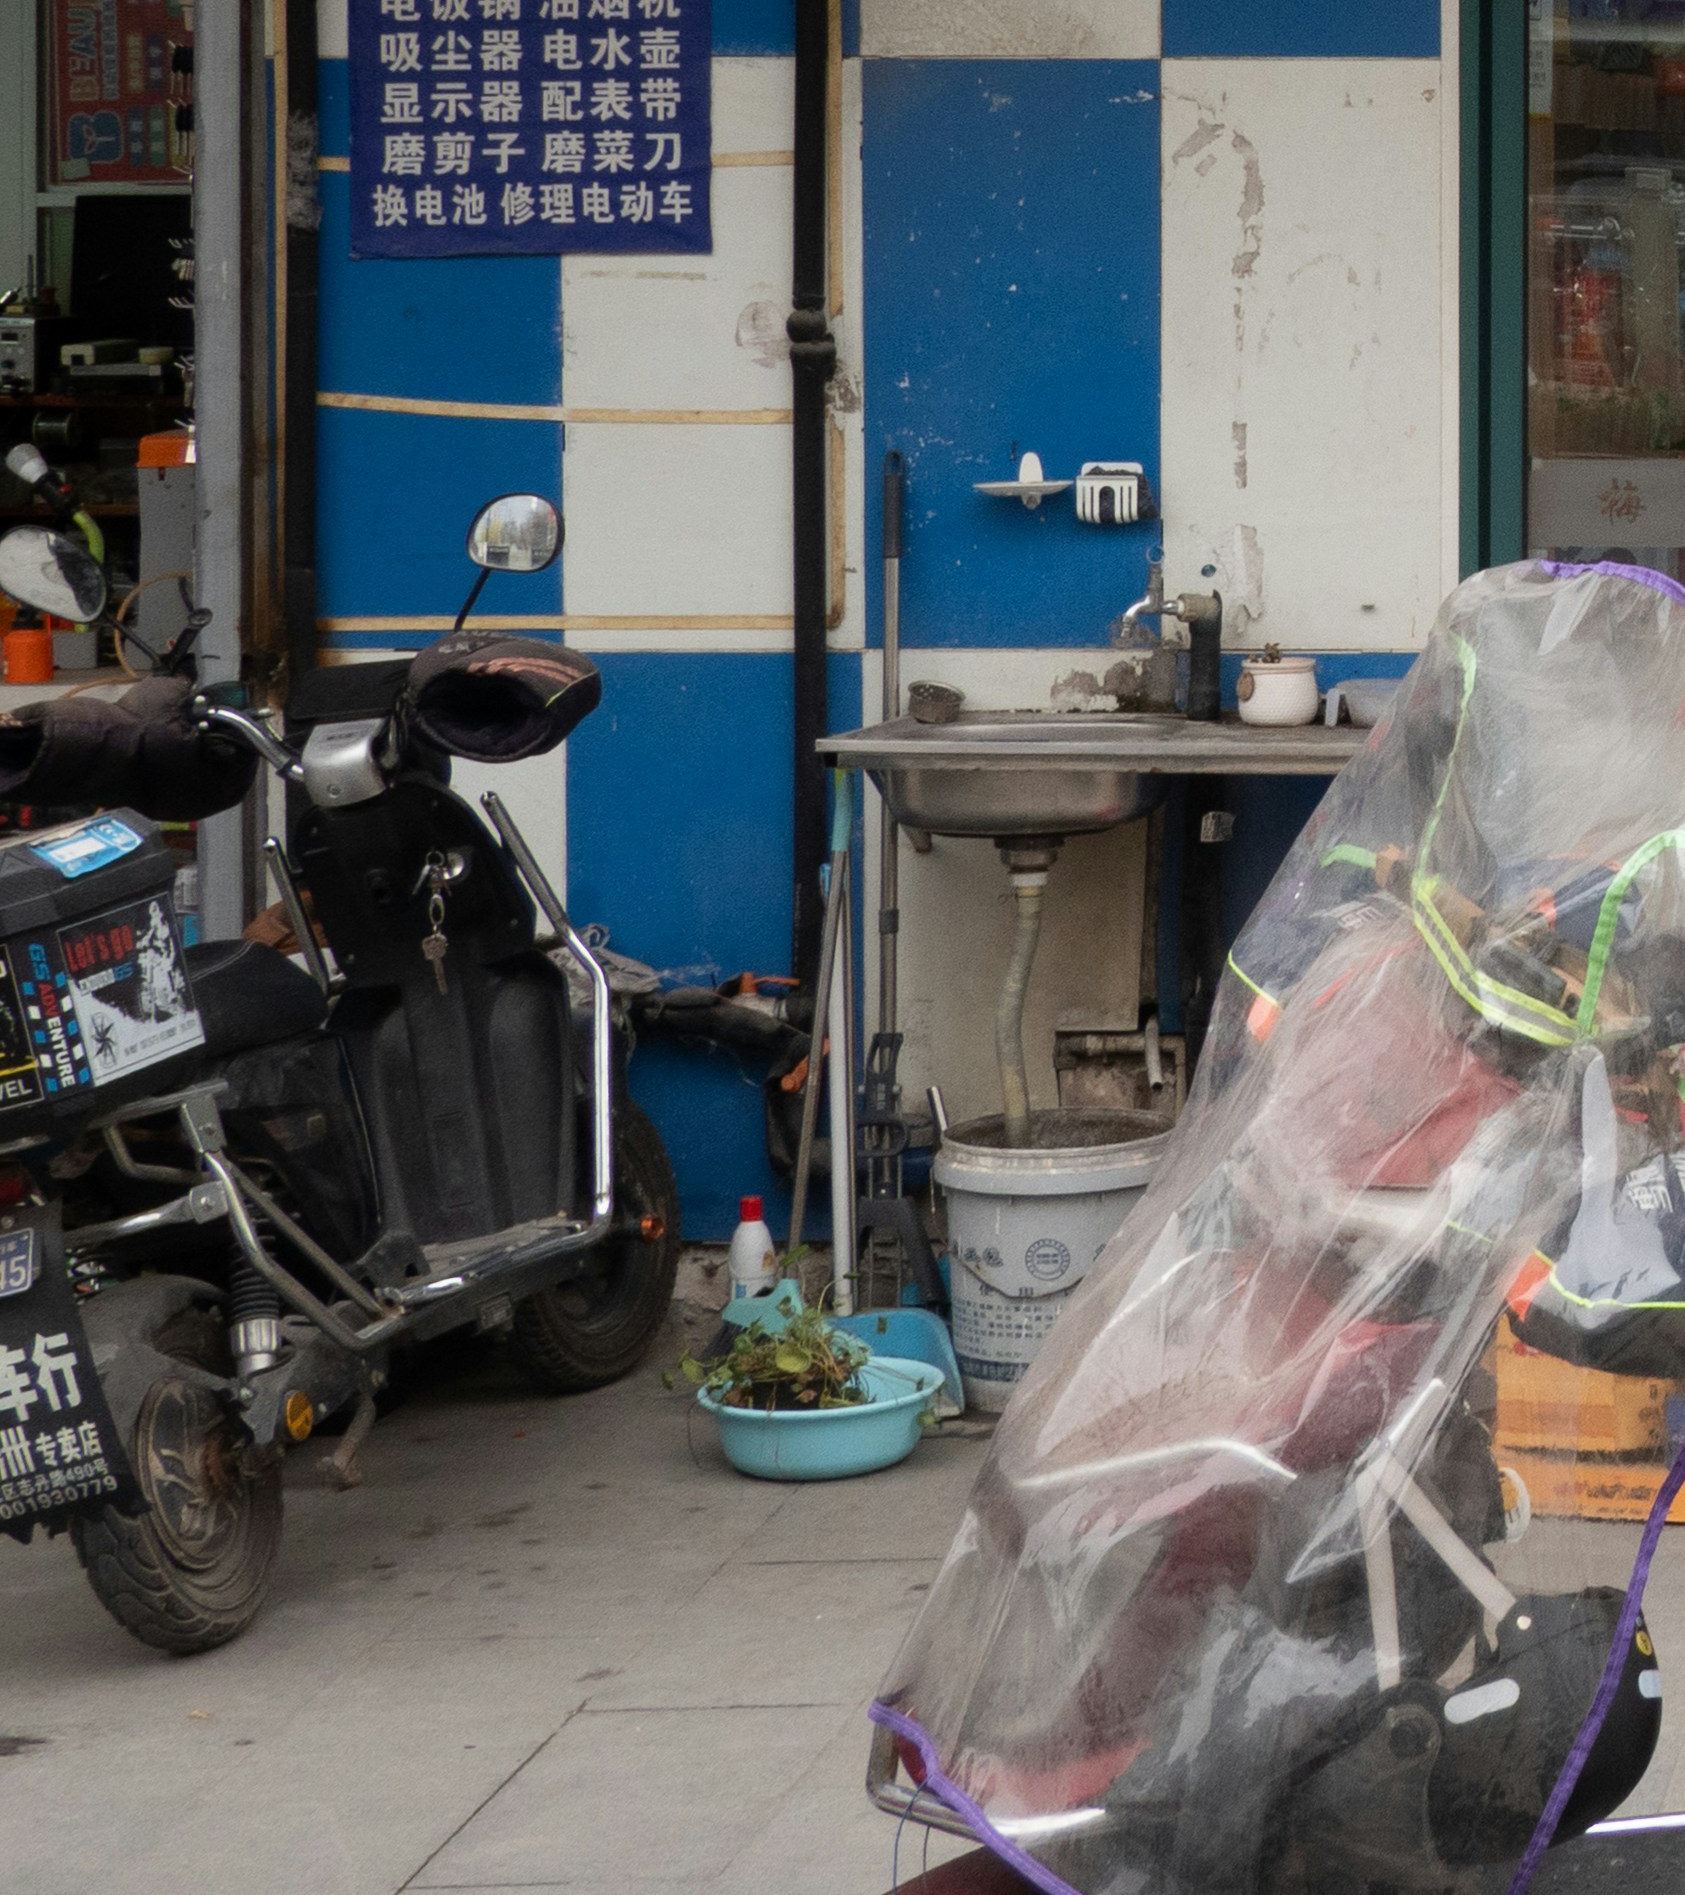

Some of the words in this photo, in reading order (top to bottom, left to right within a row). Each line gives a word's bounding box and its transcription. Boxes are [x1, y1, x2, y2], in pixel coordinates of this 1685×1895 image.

[380, 31, 523, 72] 吸尘器
[544, 28, 681, 70] 电水壶
[381, 82, 523, 124] 显示器
[542, 79, 682, 123] 配表带
[382, 133, 525, 176] 磨剪子
[543, 132, 682, 174] 磨菜刀
[373, 184, 487, 227] 换电池
[500, 182, 693, 226] 修理电动车
[36, 983, 77, 1088] ADVENTURE
[35, 1421, 102, 1469] 专卖店
